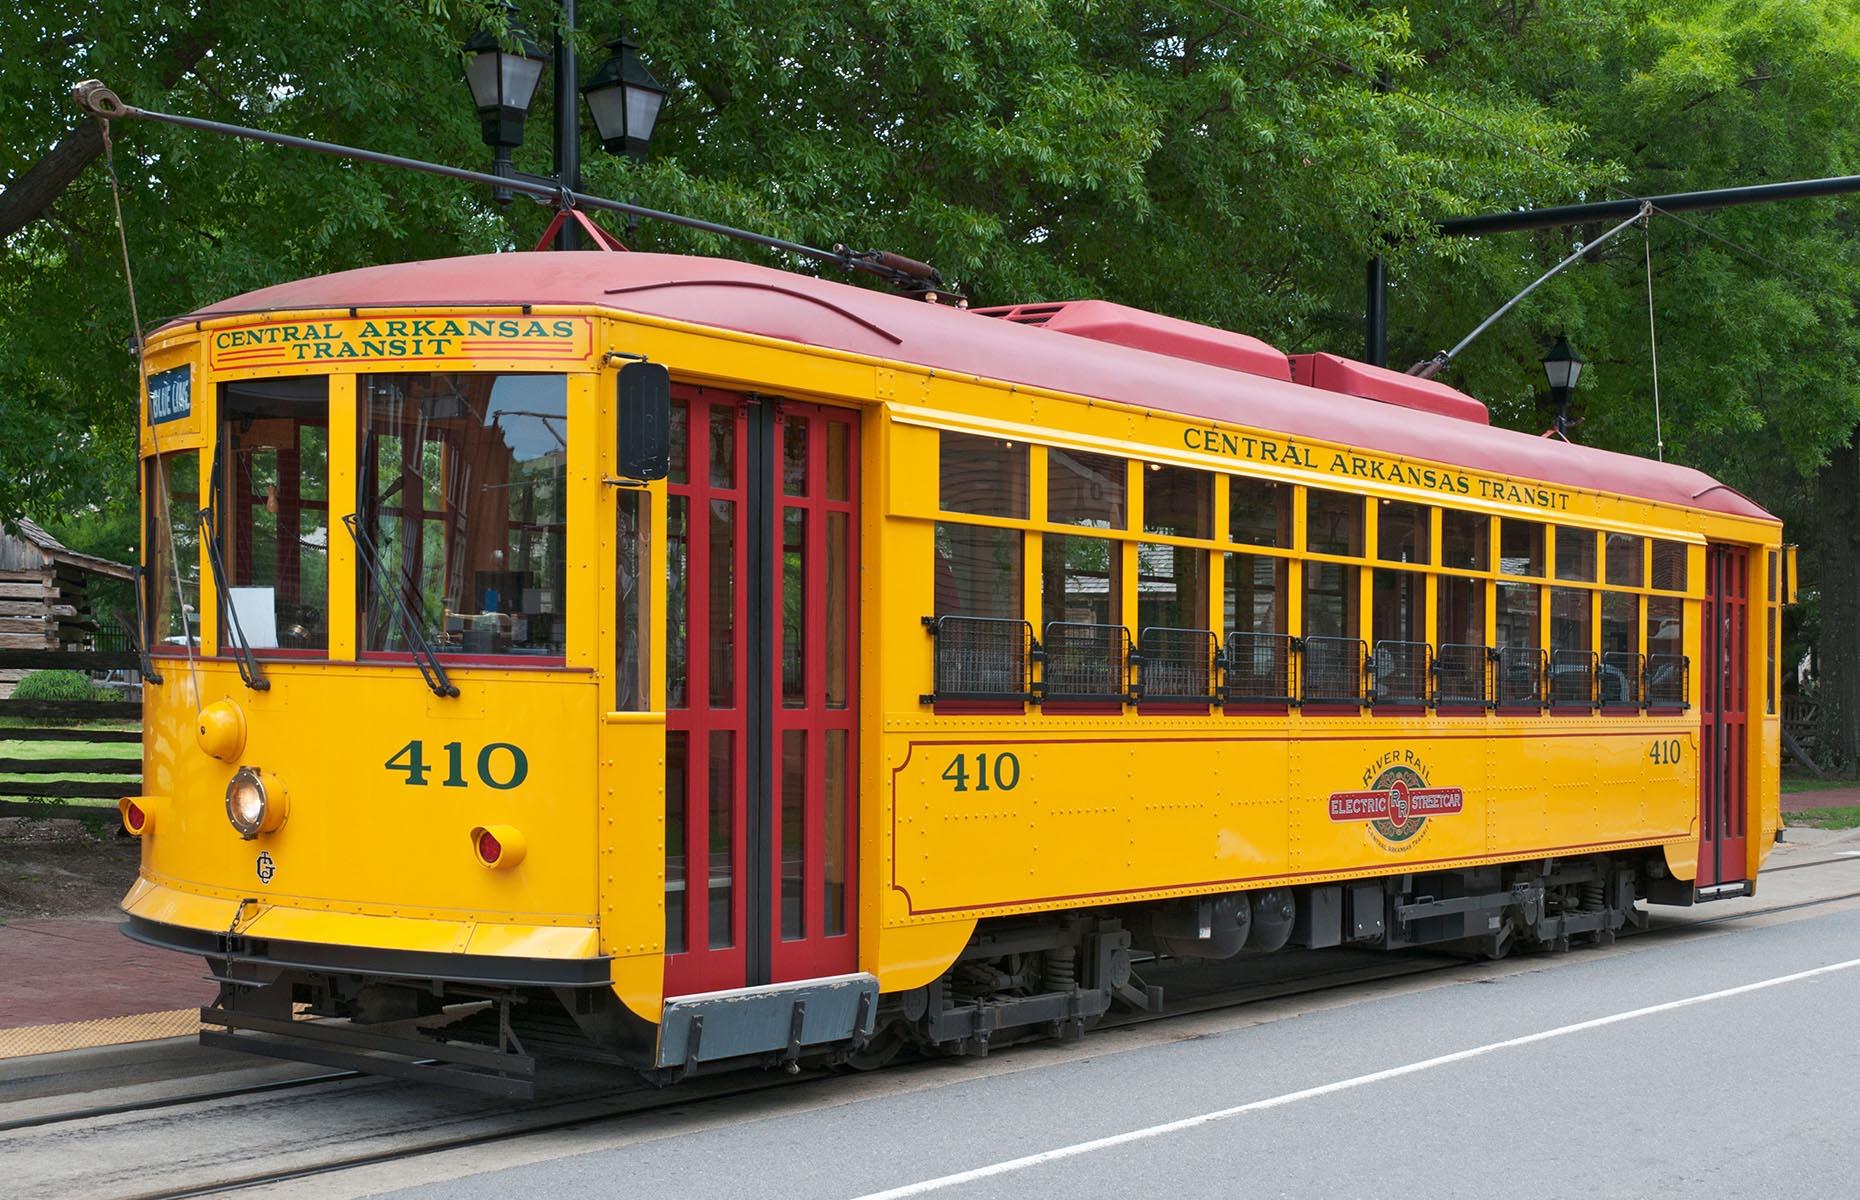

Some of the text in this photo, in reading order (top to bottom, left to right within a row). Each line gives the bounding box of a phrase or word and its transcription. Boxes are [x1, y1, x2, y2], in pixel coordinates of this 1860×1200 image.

[217, 320, 574, 349] CENTRAL ARKANSAS
[292, 339, 452, 360] TRANSIT
[153, 385, 171, 418] BLUE
[1183, 428, 1570, 510] CENTRAL ARKANSAS TRANSIT
[384, 740, 528, 790] 410
[1361, 749, 1432, 788] RIVER RAIL
[1649, 739, 1680, 765] 410
[941, 752, 1020, 792] 410
[1331, 797, 1387, 815] ELECTRIC
[1411, 793, 1461, 811] STREETCAR
